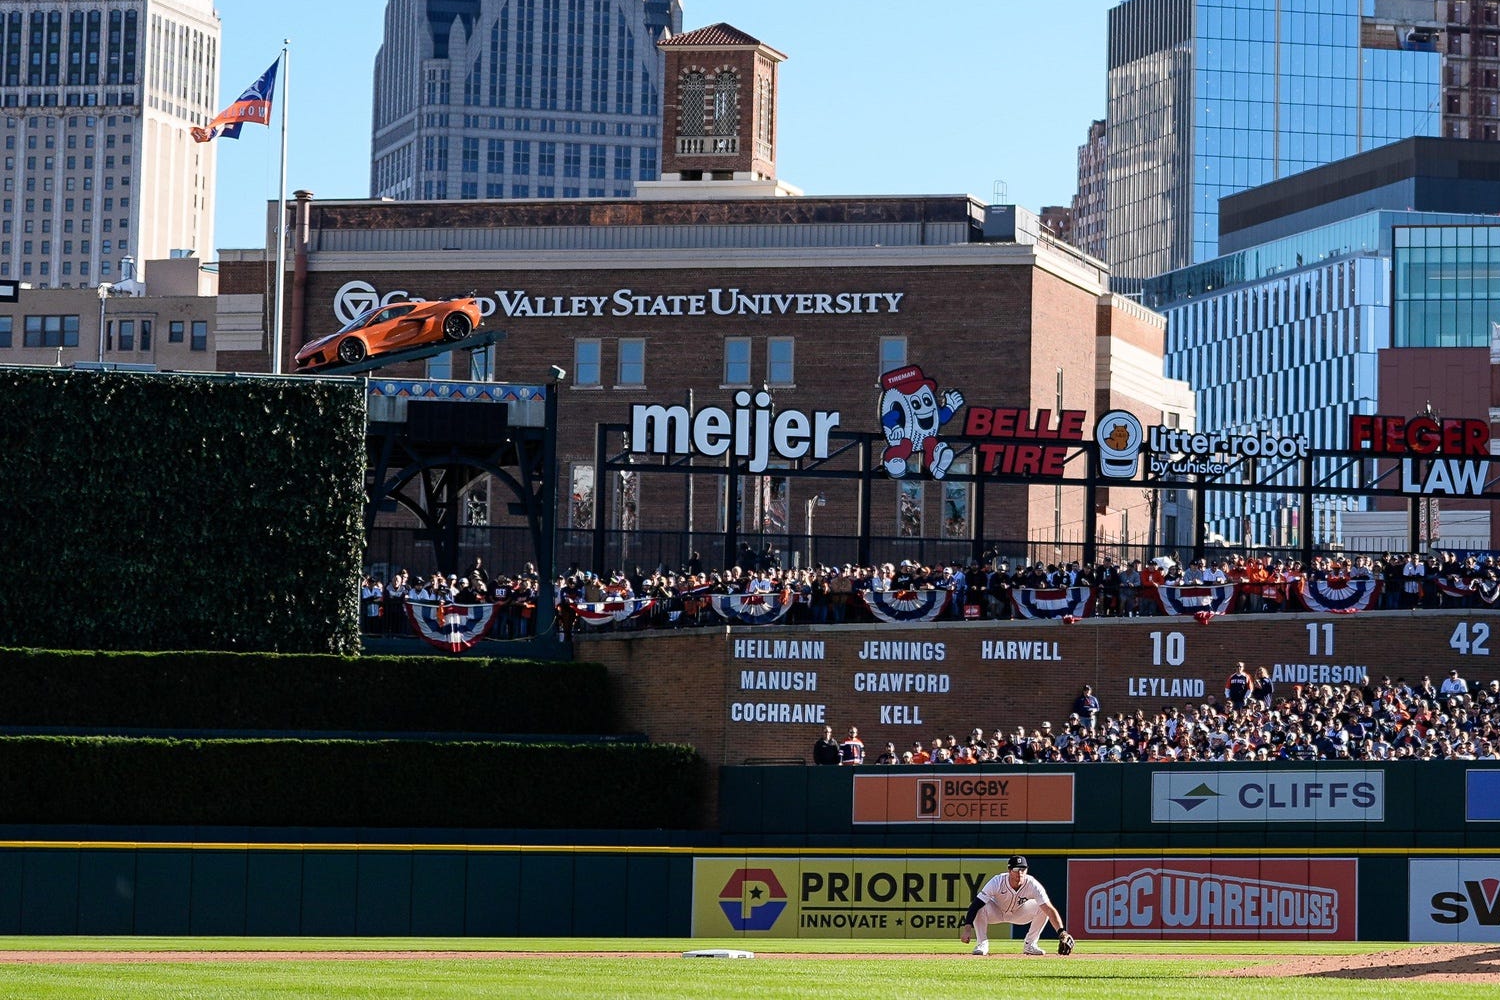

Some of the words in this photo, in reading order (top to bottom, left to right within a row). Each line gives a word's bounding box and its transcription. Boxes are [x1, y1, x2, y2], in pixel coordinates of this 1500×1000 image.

[495, 290, 609, 317] VALLEY
[611, 288, 706, 316] STATE
[708, 288, 904, 315] UNIVERSITY
[888, 370, 916, 384] TIREMAN
[632, 391, 839, 473] meijer
[965, 407, 1086, 440] BELLE
[1352, 416, 1490, 455] FIEGER
[979, 444, 1068, 475] TIRE
[1150, 457, 1168, 475] by
[1172, 460, 1229, 474] whisker
[1402, 458, 1490, 495] LAW
[1149, 631, 1185, 666] 10
[1305, 622, 1334, 656] 11
[1449, 622, 1491, 656] 42
[734, 640, 825, 661] HEILMANN
[858, 641, 946, 661] JENNINGS
[981, 640, 1062, 661] HARWELL
[740, 670, 817, 692] MANUSH
[854, 672, 950, 693] CRAWFORD
[1272, 663, 1367, 685] ANDERSON
[1128, 677, 1205, 698] LEYLAND
[731, 703, 826, 724] COCHRANE
[879, 705, 923, 725] KELL
[921, 783, 937, 814] B
[944, 781, 1009, 796] BIGGBY
[1238, 781, 1376, 809] CLIFFS
[944, 803, 1009, 817] COFFEE
[801, 872, 987, 903] PRIORITY
[1090, 875, 1154, 928] ABC
[1160, 876, 1335, 928] WAREHOUSE
[800, 914, 887, 928] INNOVATE
[910, 914, 968, 929] OPERA
